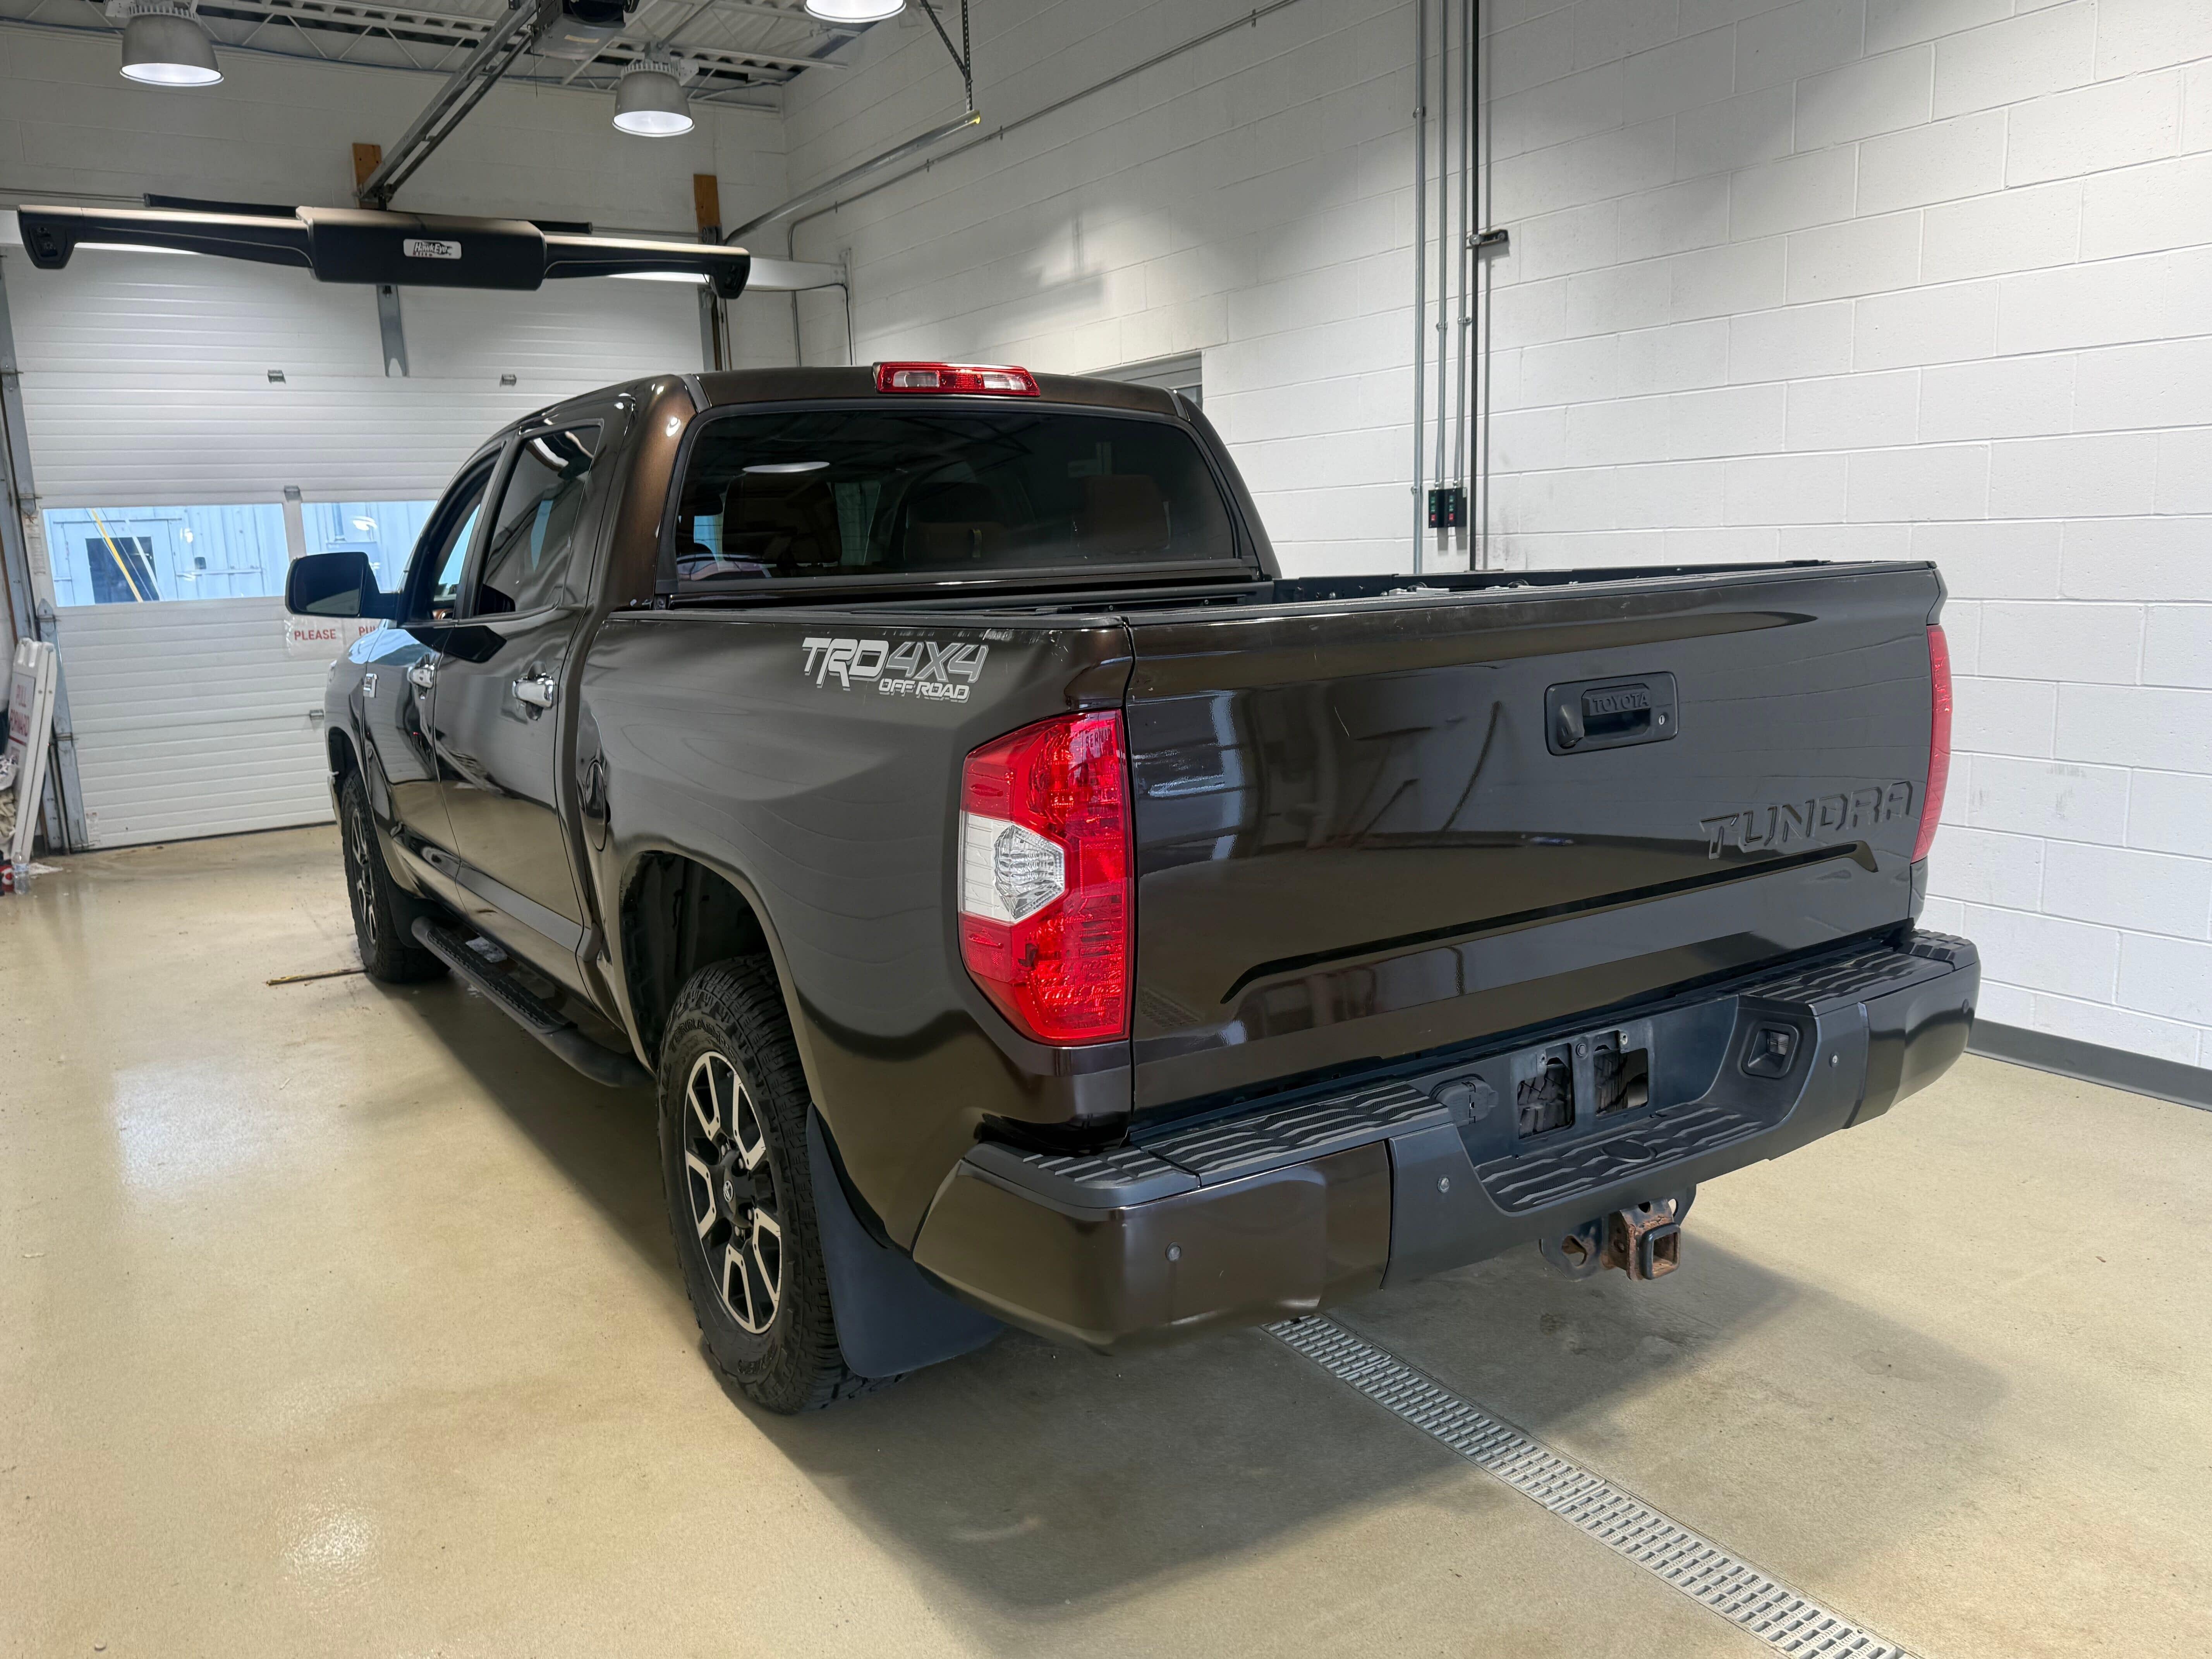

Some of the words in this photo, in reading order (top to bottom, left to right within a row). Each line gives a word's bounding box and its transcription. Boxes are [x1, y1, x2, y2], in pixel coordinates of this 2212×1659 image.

[294, 629, 336, 641] PLEASE
[802, 637, 890, 691] TRD
[878, 678, 916, 697] OFF
[915, 681, 970, 703] ROAD
[1593, 692, 1649, 713] TOYOTA
[1699, 780, 1913, 860] TUNDRA
